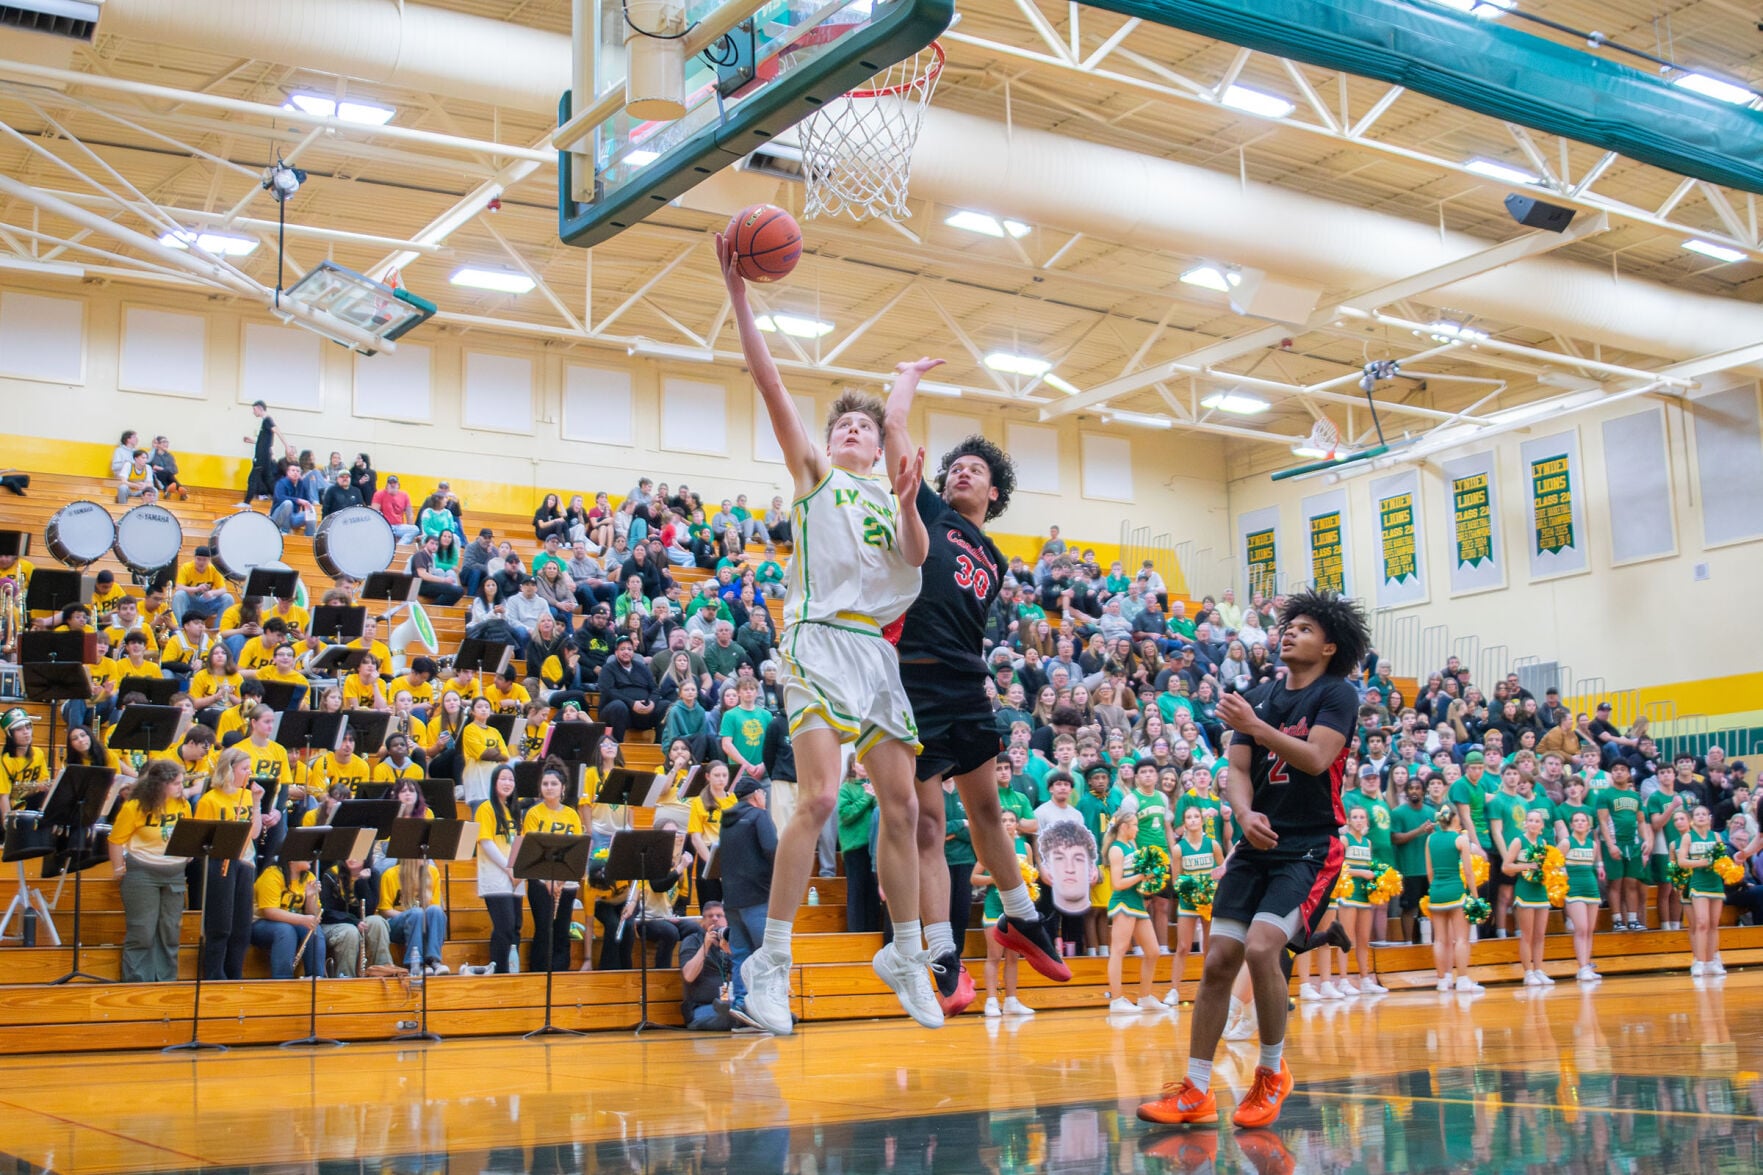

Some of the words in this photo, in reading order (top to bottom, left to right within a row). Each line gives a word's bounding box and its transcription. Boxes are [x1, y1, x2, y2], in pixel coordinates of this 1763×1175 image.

[1531, 458, 1569, 478] LYNDEN
[1453, 474, 1488, 493] LYNDEN
[1537, 475, 1567, 494] LIONS
[1379, 494, 1412, 513] LYNDEN
[1457, 490, 1486, 508] LIONS
[1535, 494, 1559, 508] CLASS
[144, 513, 169, 523] YAMAHA
[1310, 514, 1341, 532] LYNDEN
[1383, 509, 1410, 527] LIONS
[1456, 509, 1478, 521] CLASS
[1314, 530, 1339, 546] LIONS
[1382, 526, 1403, 539] CLASS
[1250, 547, 1273, 562] LIONS
[1312, 547, 1332, 558] CLASS
[954, 554, 989, 600] 30
[255, 760, 283, 778] PB
[1268, 751, 1290, 784] 2
[1183, 857, 1214, 867] LYNDEN
